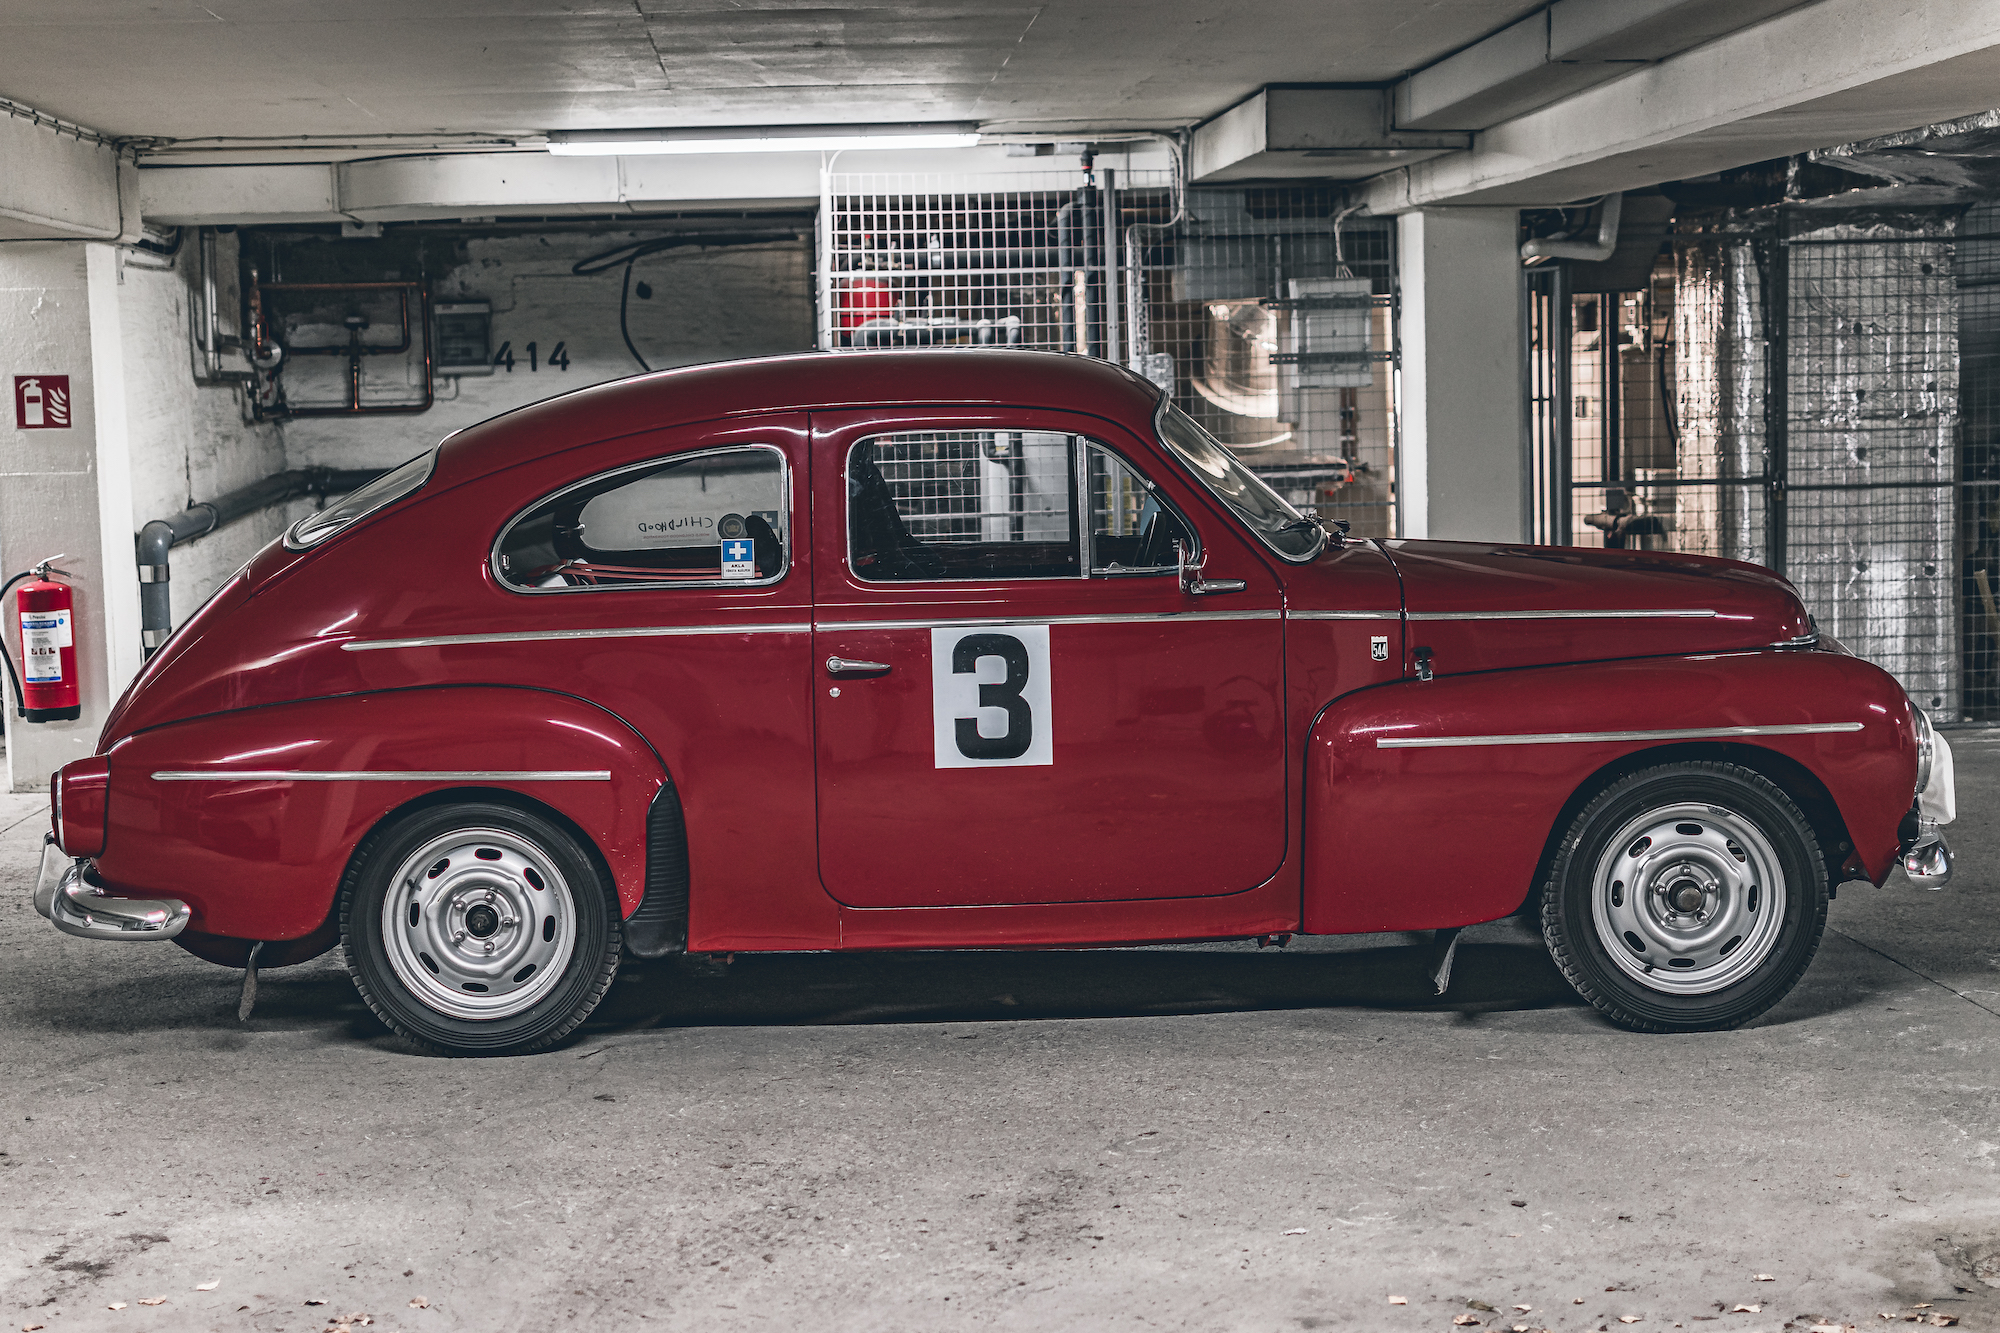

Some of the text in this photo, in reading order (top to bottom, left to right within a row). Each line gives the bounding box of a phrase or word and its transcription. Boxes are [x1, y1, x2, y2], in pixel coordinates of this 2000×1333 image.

[494, 341, 570, 372] 414
[1373, 643, 1386, 657] 544
[952, 633, 1034, 760] 3
